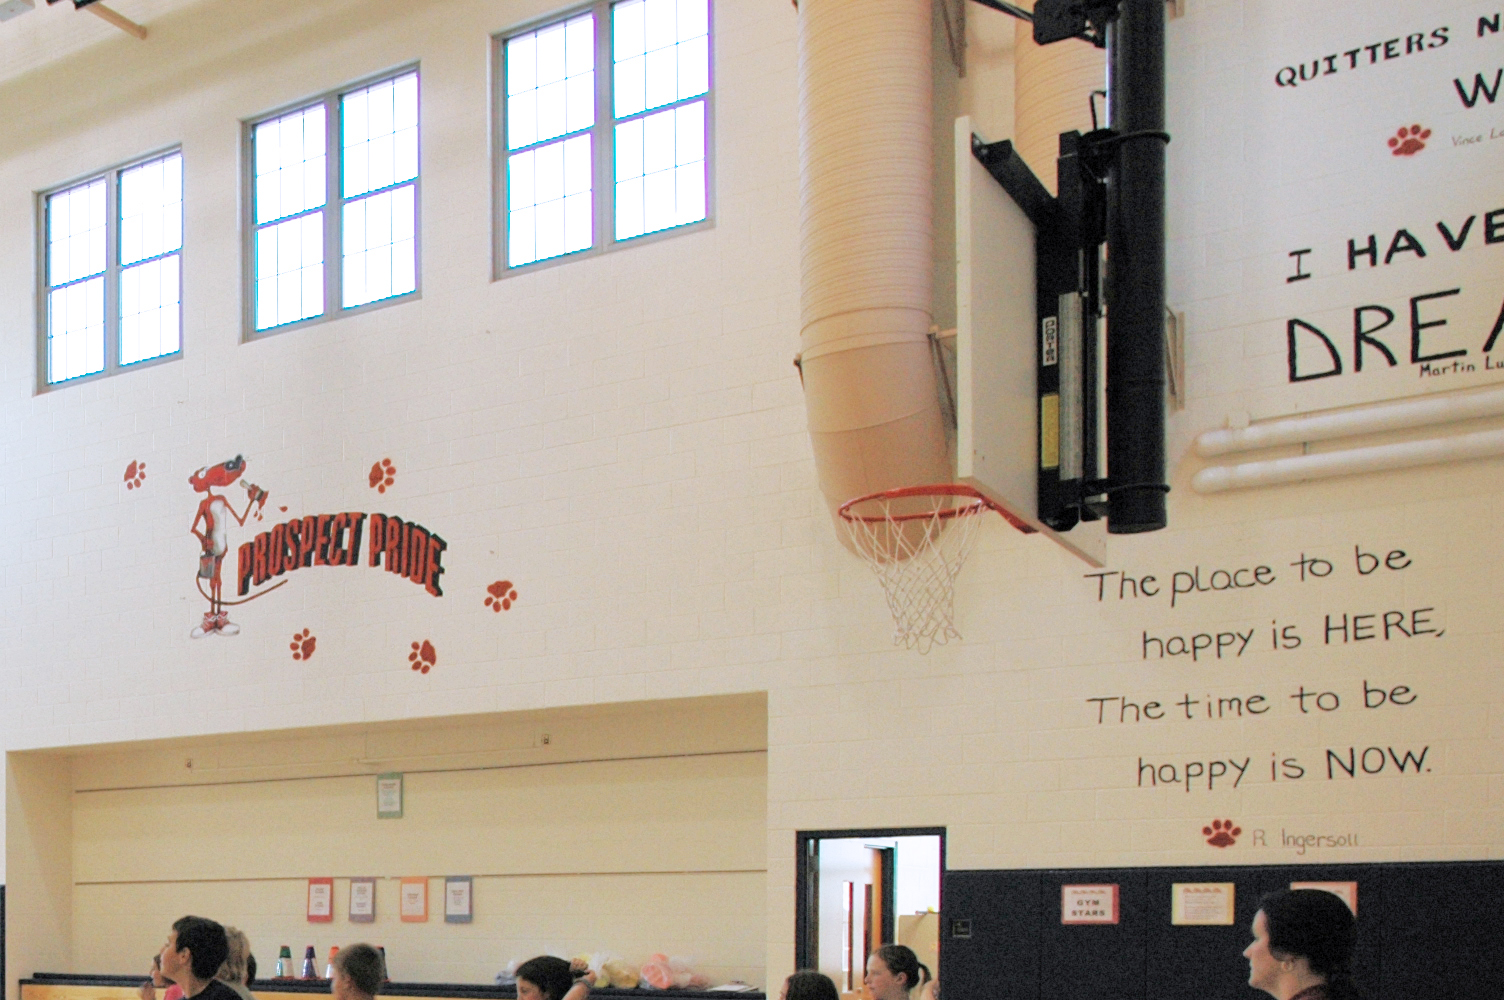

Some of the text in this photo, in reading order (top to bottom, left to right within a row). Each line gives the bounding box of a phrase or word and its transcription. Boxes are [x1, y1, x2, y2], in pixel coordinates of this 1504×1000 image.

[1274, 25, 1451, 89] QUITTERS
[1286, 207, 1504, 285] I HAVE
[1419, 361, 1476, 379] Martin
[237, 511, 447, 598] PROSPECT PRIDE
[1083, 544, 1413, 608] The place to be
[1142, 607, 1446, 662] happy is HERE,
[1086, 679, 1419, 725] The time to be
[1137, 745, 1434, 793] happy is NOW.
[1281, 827, 1360, 856] Ingersoll
[1070, 909, 1107, 918] STARS
[1075, 899, 1101, 907] GYM
